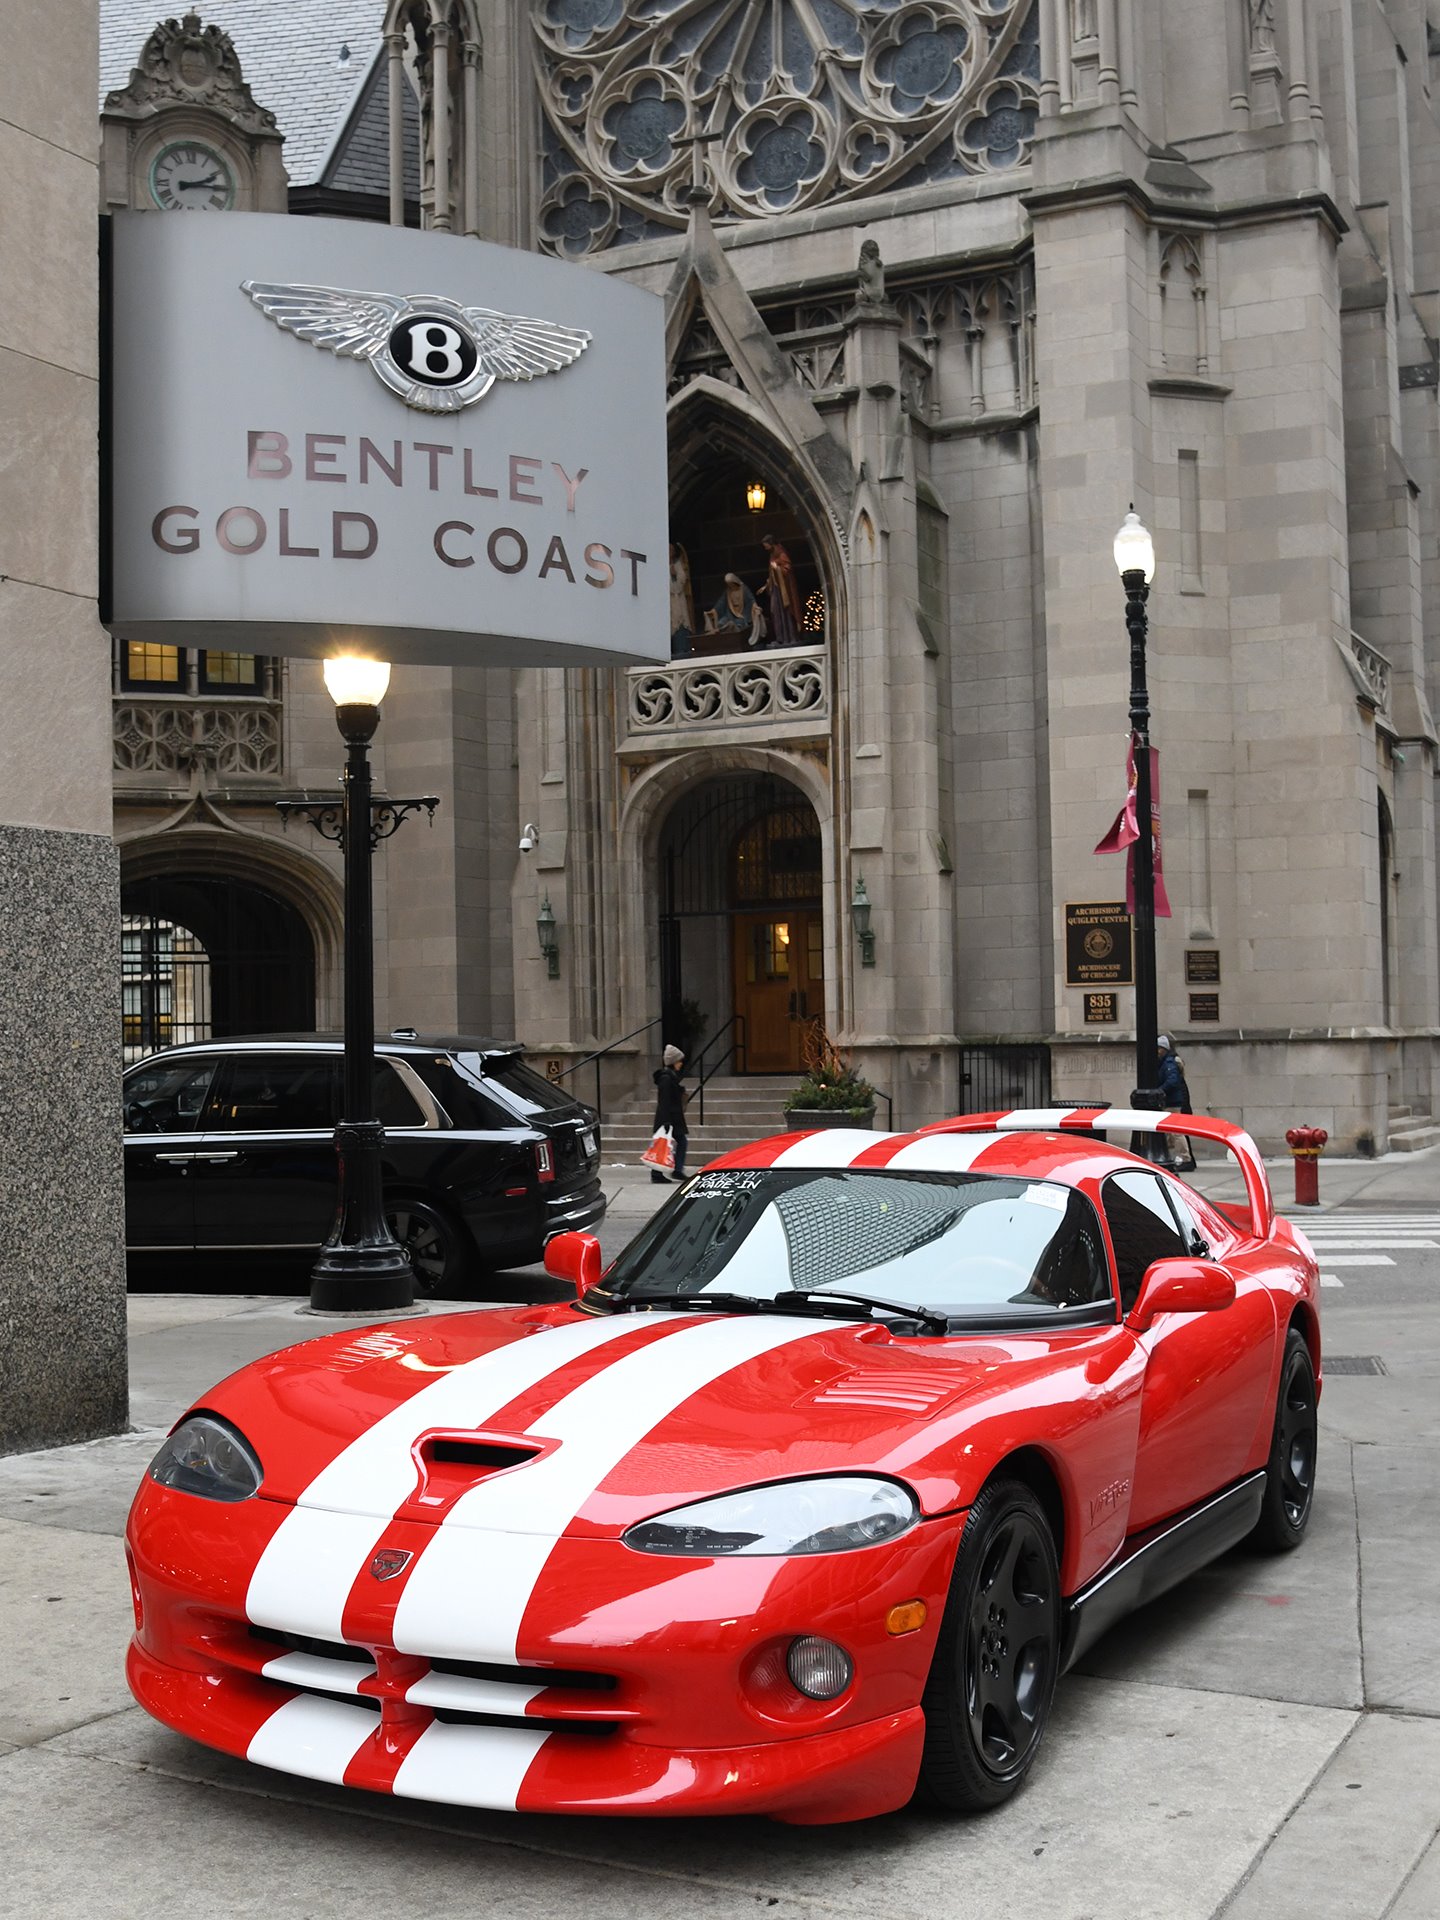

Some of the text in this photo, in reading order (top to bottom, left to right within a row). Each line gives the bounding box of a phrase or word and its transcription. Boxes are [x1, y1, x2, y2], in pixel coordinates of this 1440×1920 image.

[408, 322, 464, 379] B
[247, 430, 590, 512] BENTLEY
[151, 505, 648, 596] GOLD COAST
[1075, 907, 1121, 915] ARCHBISHOP
[1067, 916, 1129, 926] QUIGLEY CENTER
[1089, 995, 1111, 1007] 835
[696, 1180, 761, 1189] TRADE-IN
